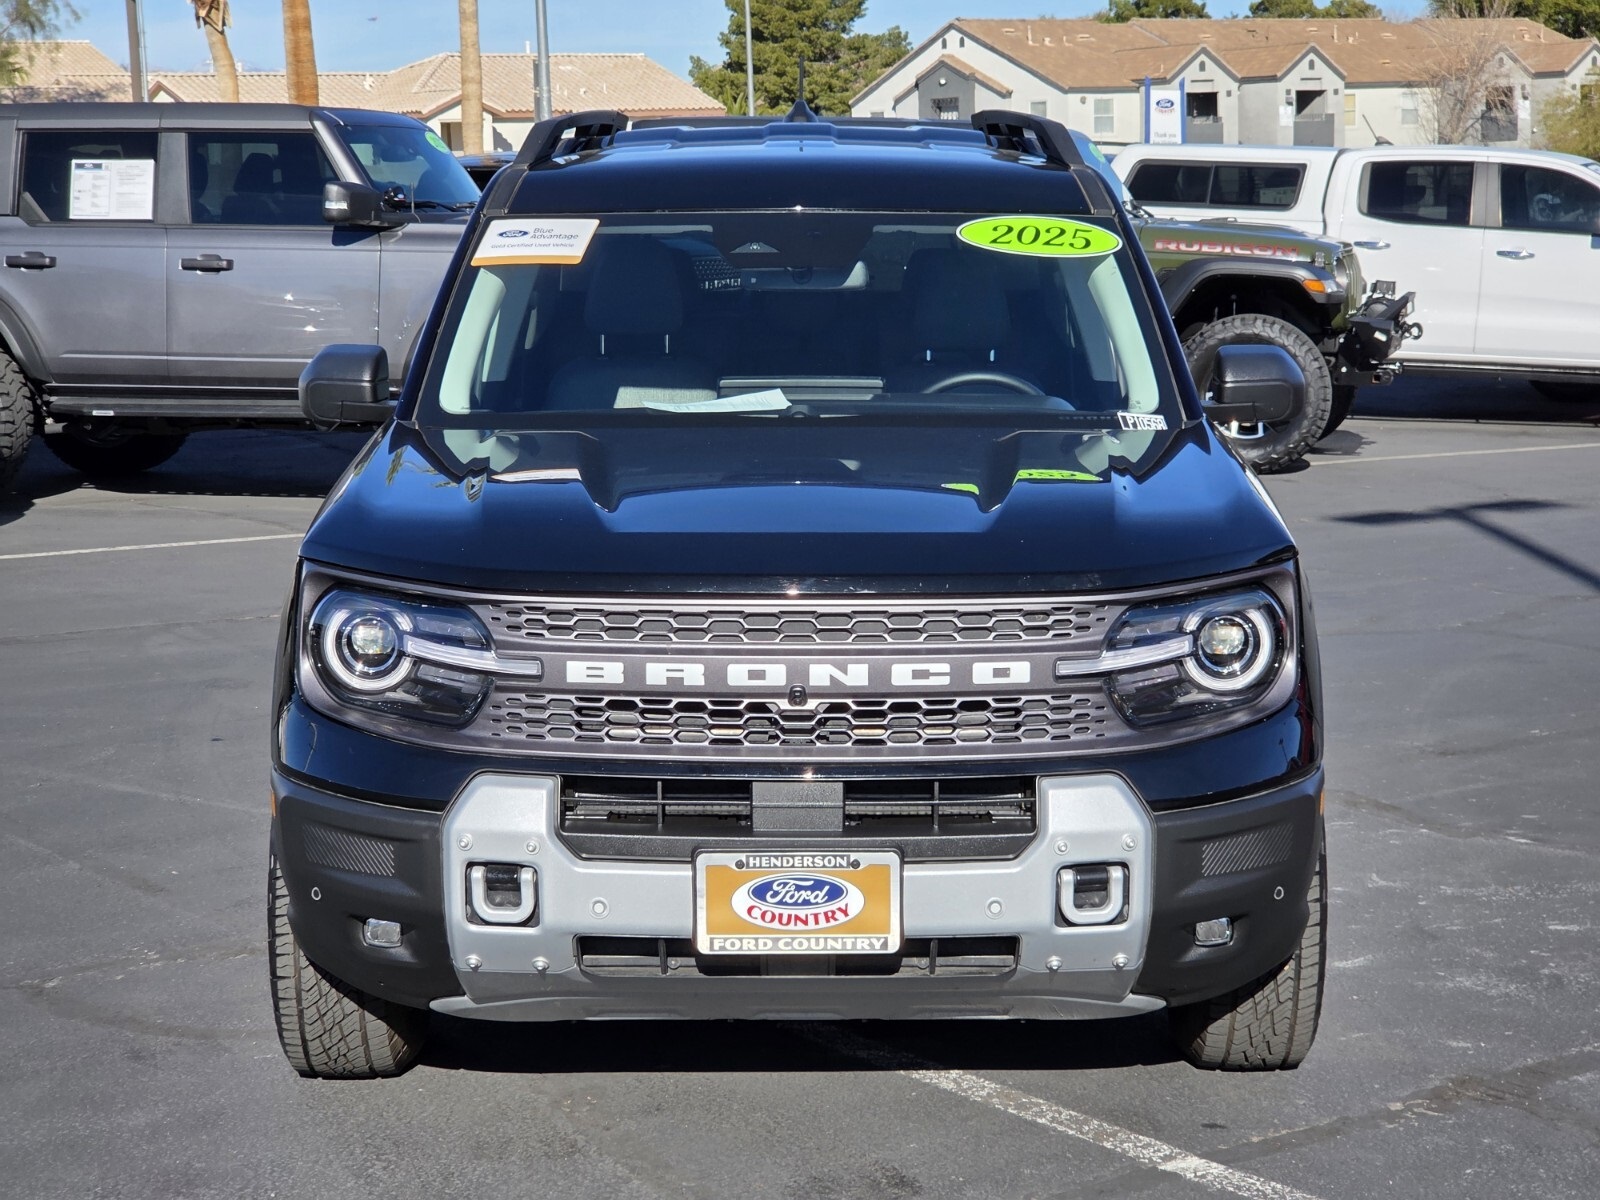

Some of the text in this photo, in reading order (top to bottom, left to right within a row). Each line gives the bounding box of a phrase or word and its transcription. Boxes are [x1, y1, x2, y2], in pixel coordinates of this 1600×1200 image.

[989, 224, 1093, 250] 2025
[1154, 239, 1299, 257] RUBICON
[565, 659, 1031, 687] BRONCO
[748, 855, 849, 868] HENDERSON
[766, 879, 831, 905] Ford
[746, 903, 850, 927] COUNTRY
[713, 937, 886, 951] FORD COUNTRY
